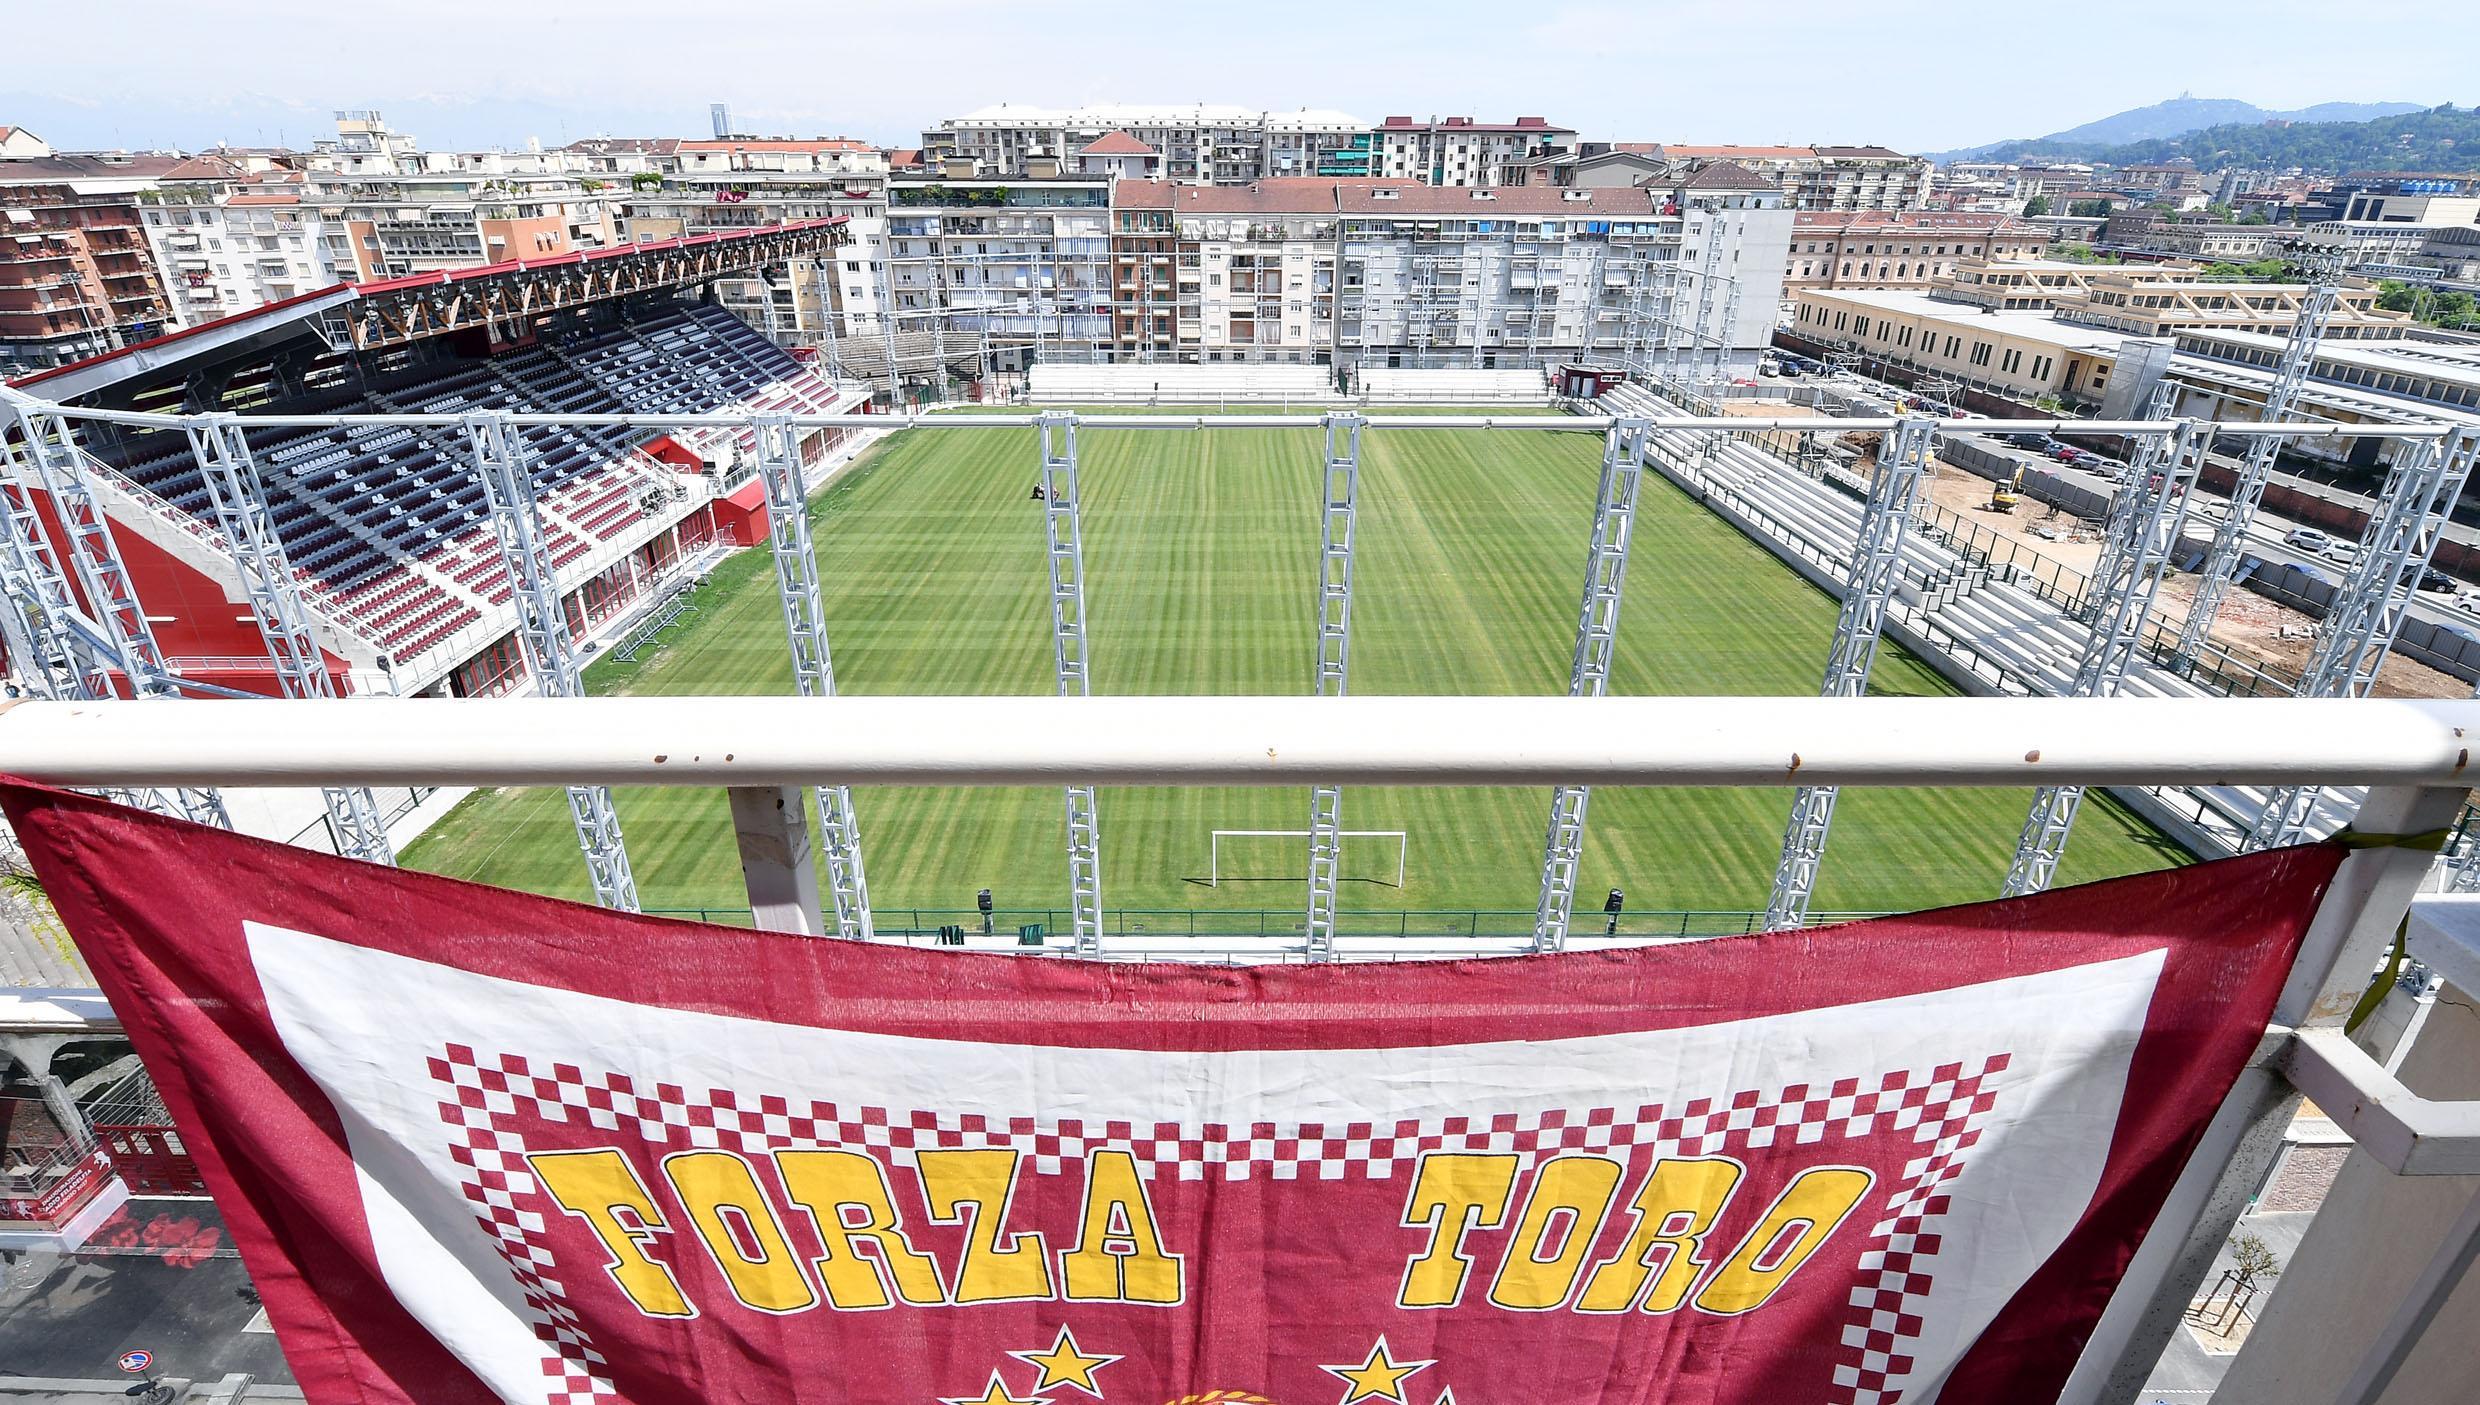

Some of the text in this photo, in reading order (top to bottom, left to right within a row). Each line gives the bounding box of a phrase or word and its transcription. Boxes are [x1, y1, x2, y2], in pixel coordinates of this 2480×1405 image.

[60, 1169, 92, 1197] FILADELFIA
[527, 1147, 1877, 1319] FORZA TORO
